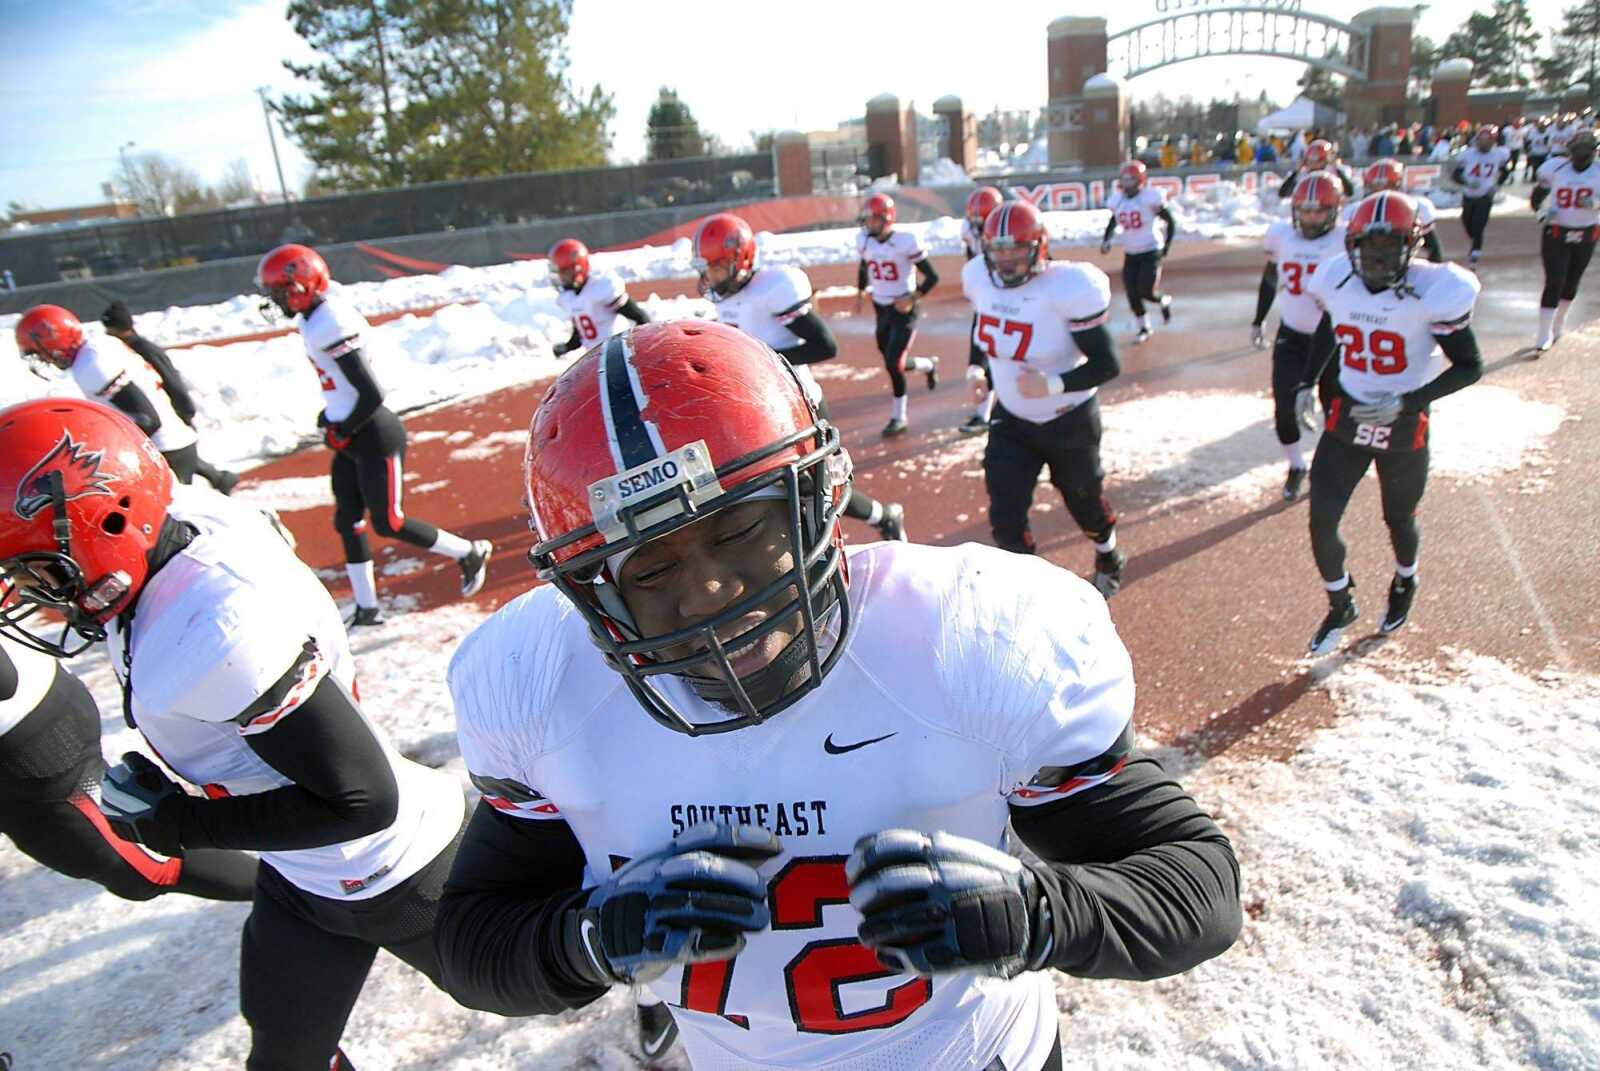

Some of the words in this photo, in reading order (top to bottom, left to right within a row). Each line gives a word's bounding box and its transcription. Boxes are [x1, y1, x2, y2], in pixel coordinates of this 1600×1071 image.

[1282, 261, 1320, 296] 3
[978, 313, 1033, 362] 57
[1335, 323, 1408, 375] 29
[619, 460, 679, 499] SEMO
[670, 800, 827, 839] SOUTHEAST
